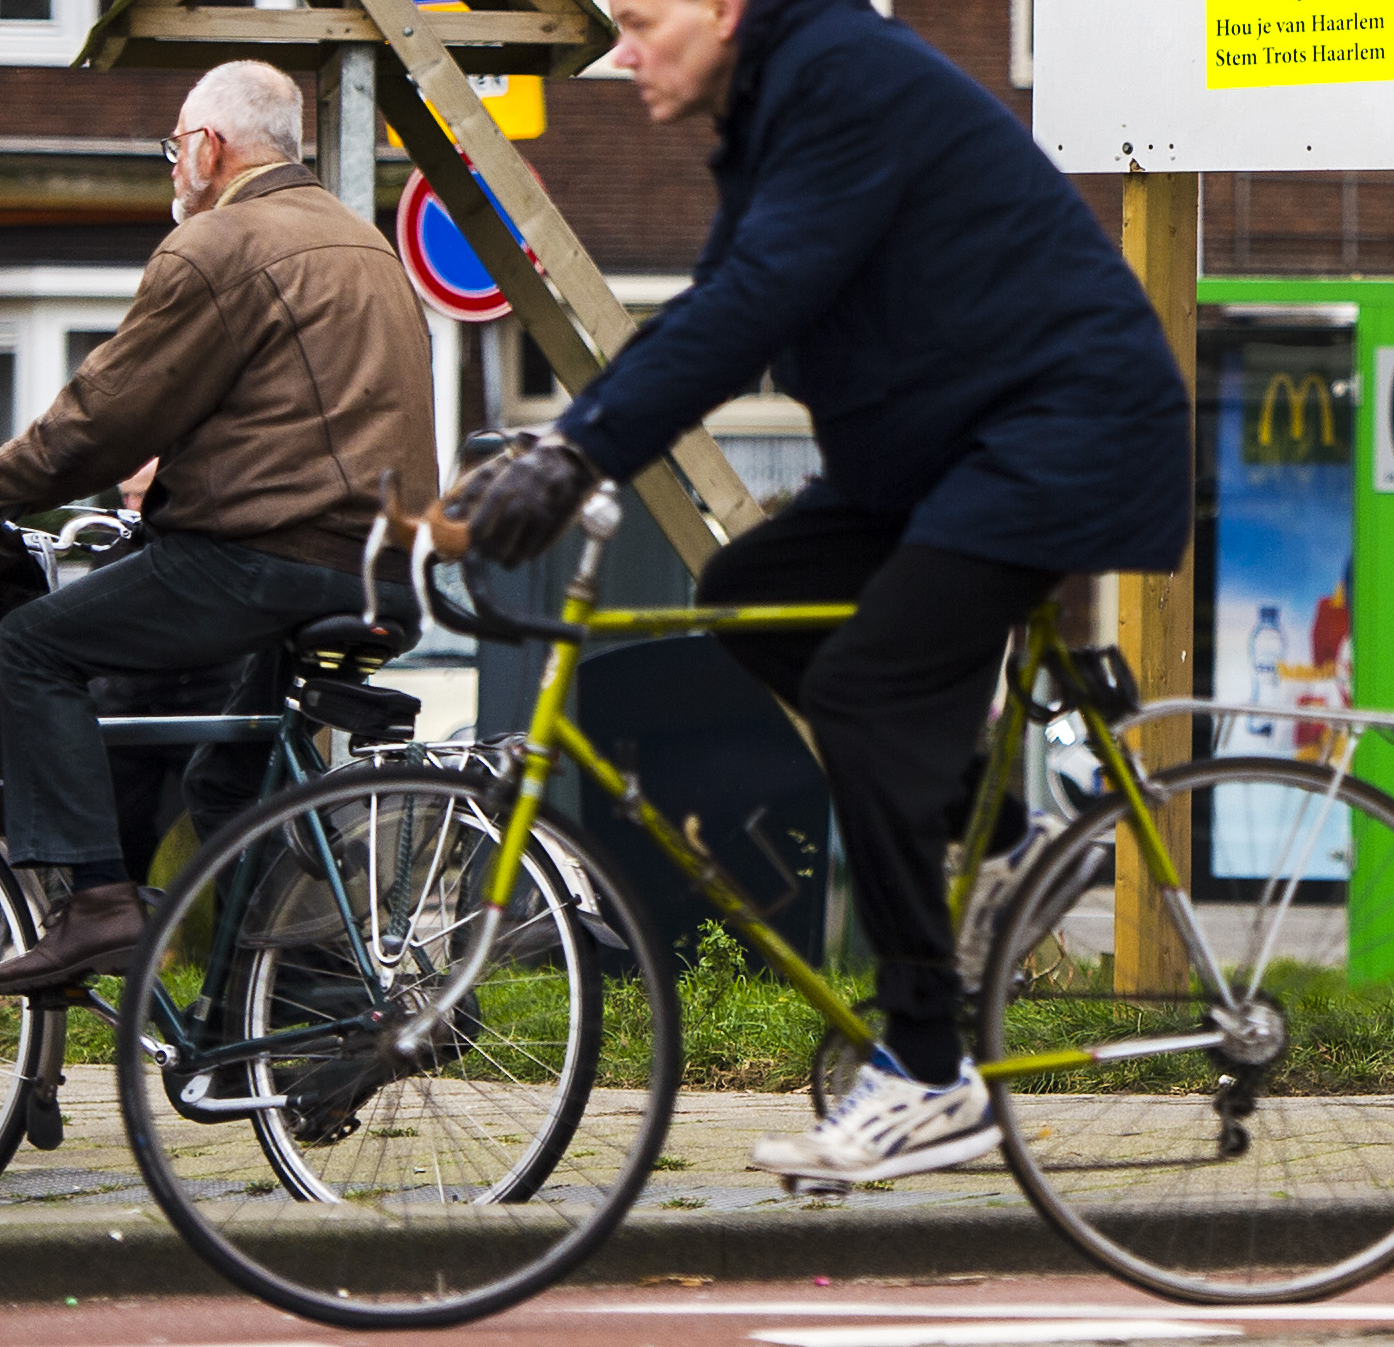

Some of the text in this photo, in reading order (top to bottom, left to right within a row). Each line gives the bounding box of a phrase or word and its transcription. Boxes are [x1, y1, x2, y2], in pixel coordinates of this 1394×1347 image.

[1216, 12, 1385, 41] Hou je van Haarlem
[1215, 42, 1386, 67] Stem Trots Haarlem
